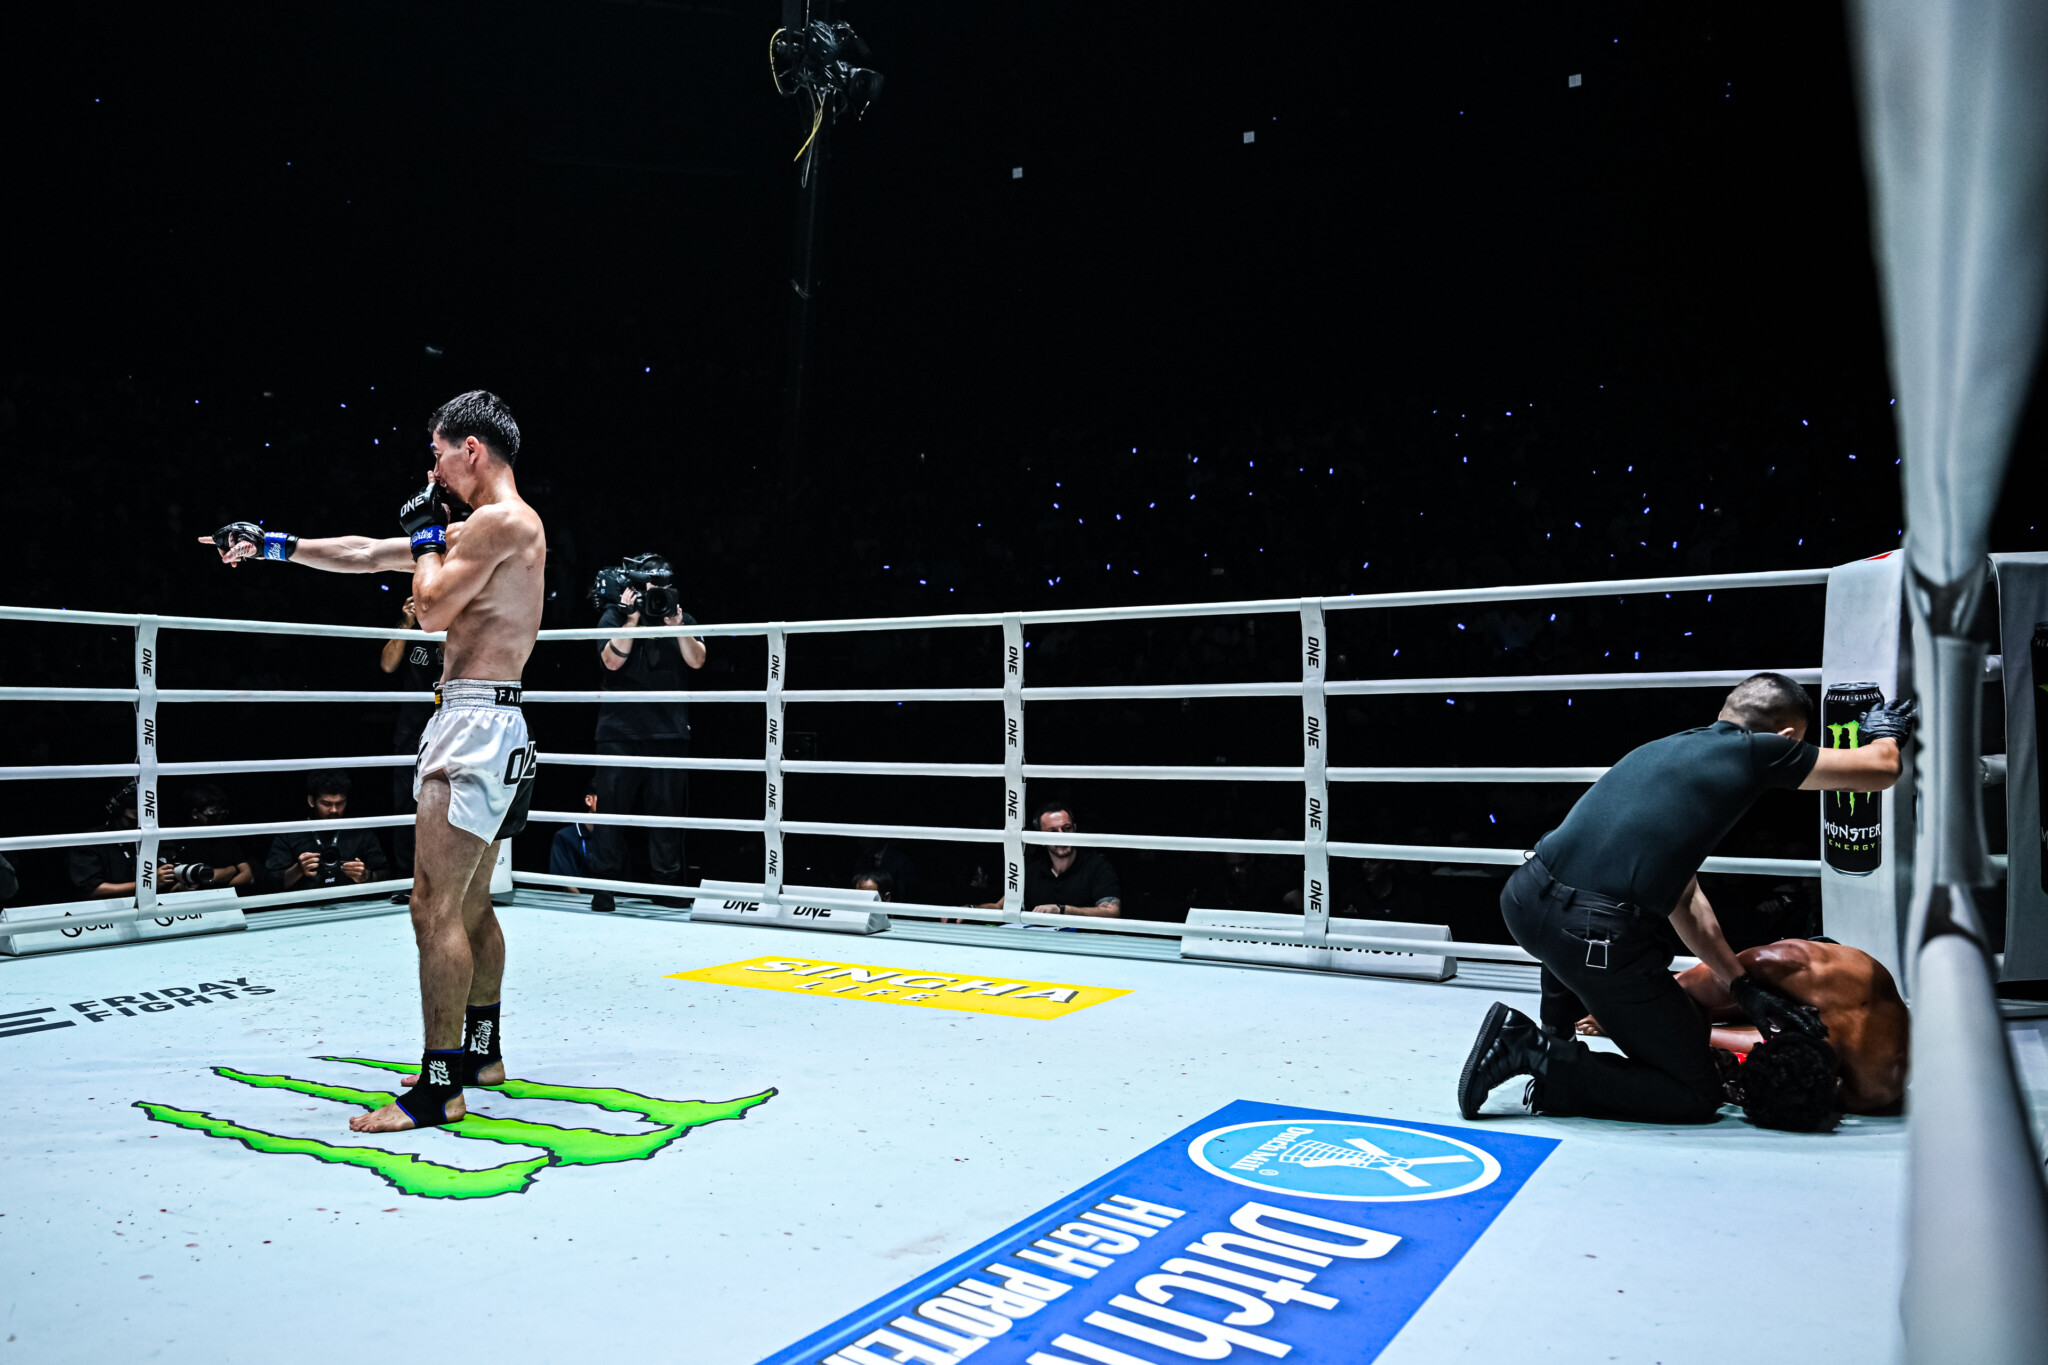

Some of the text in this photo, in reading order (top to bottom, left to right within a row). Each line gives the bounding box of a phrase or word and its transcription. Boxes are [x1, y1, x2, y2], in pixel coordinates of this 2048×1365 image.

[400, 493, 425, 517] ONE
[142, 648, 153, 677] ONE
[1008, 646, 1019, 674] ONE
[1306, 637, 1320, 668] ONE
[771, 655, 780, 680] ONE
[498, 689, 522, 703] FAI
[143, 719, 154, 746] ONE
[769, 719, 778, 745] ONE
[1007, 718, 1018, 747] ONE
[1307, 716, 1321, 749] ONE
[144, 790, 155, 818] ONE
[1008, 790, 1018, 819] ONE
[1309, 798, 1322, 830] ONE
[1824, 820, 1881, 842] MONSTER
[1828, 839, 1876, 851] ENERGY
[142, 861, 153, 889] ONE
[769, 850, 777, 876] ONE
[1008, 862, 1019, 892] ONE
[1309, 880, 1323, 913] ONE
[69, 977, 249, 1013] FRIDAY
[743, 960, 1080, 1003] SINGHA
[794, 982, 940, 1002] LIFE
[83, 985, 276, 1023] FIGHTS
[469, 1019, 494, 1055] Fairtex
[1229, 1126, 1315, 1171] Dutch Mill
[1012, 1194, 1187, 1279] HIGH
[1109, 1200, 1403, 1361] Dutch
[815, 1263, 1074, 1365] PROTE
